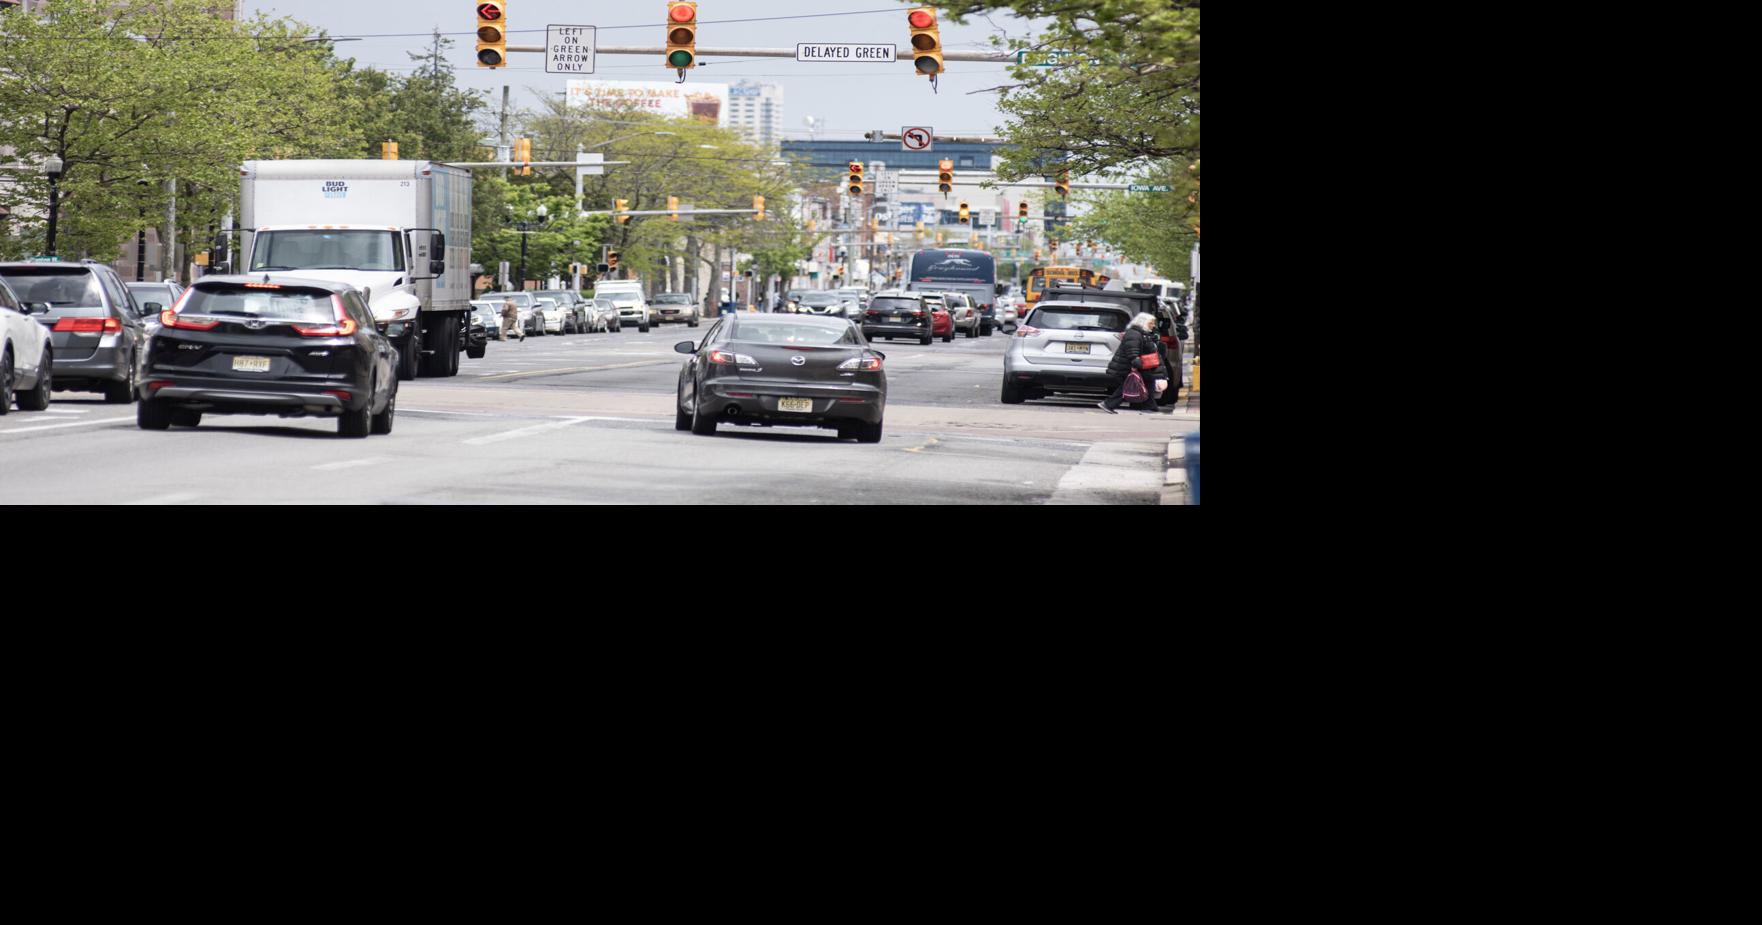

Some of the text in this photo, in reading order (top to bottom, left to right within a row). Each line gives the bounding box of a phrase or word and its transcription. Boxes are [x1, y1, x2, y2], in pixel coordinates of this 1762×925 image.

[559, 27, 583, 35] LEFT
[564, 36, 578, 44] ON
[553, 45, 588, 53] GREEN
[804, 46, 890, 59] DELAYED GREEN
[553, 54, 588, 62] ARROW
[557, 63, 583, 71] ONLY
[647, 88, 680, 98] MAKE
